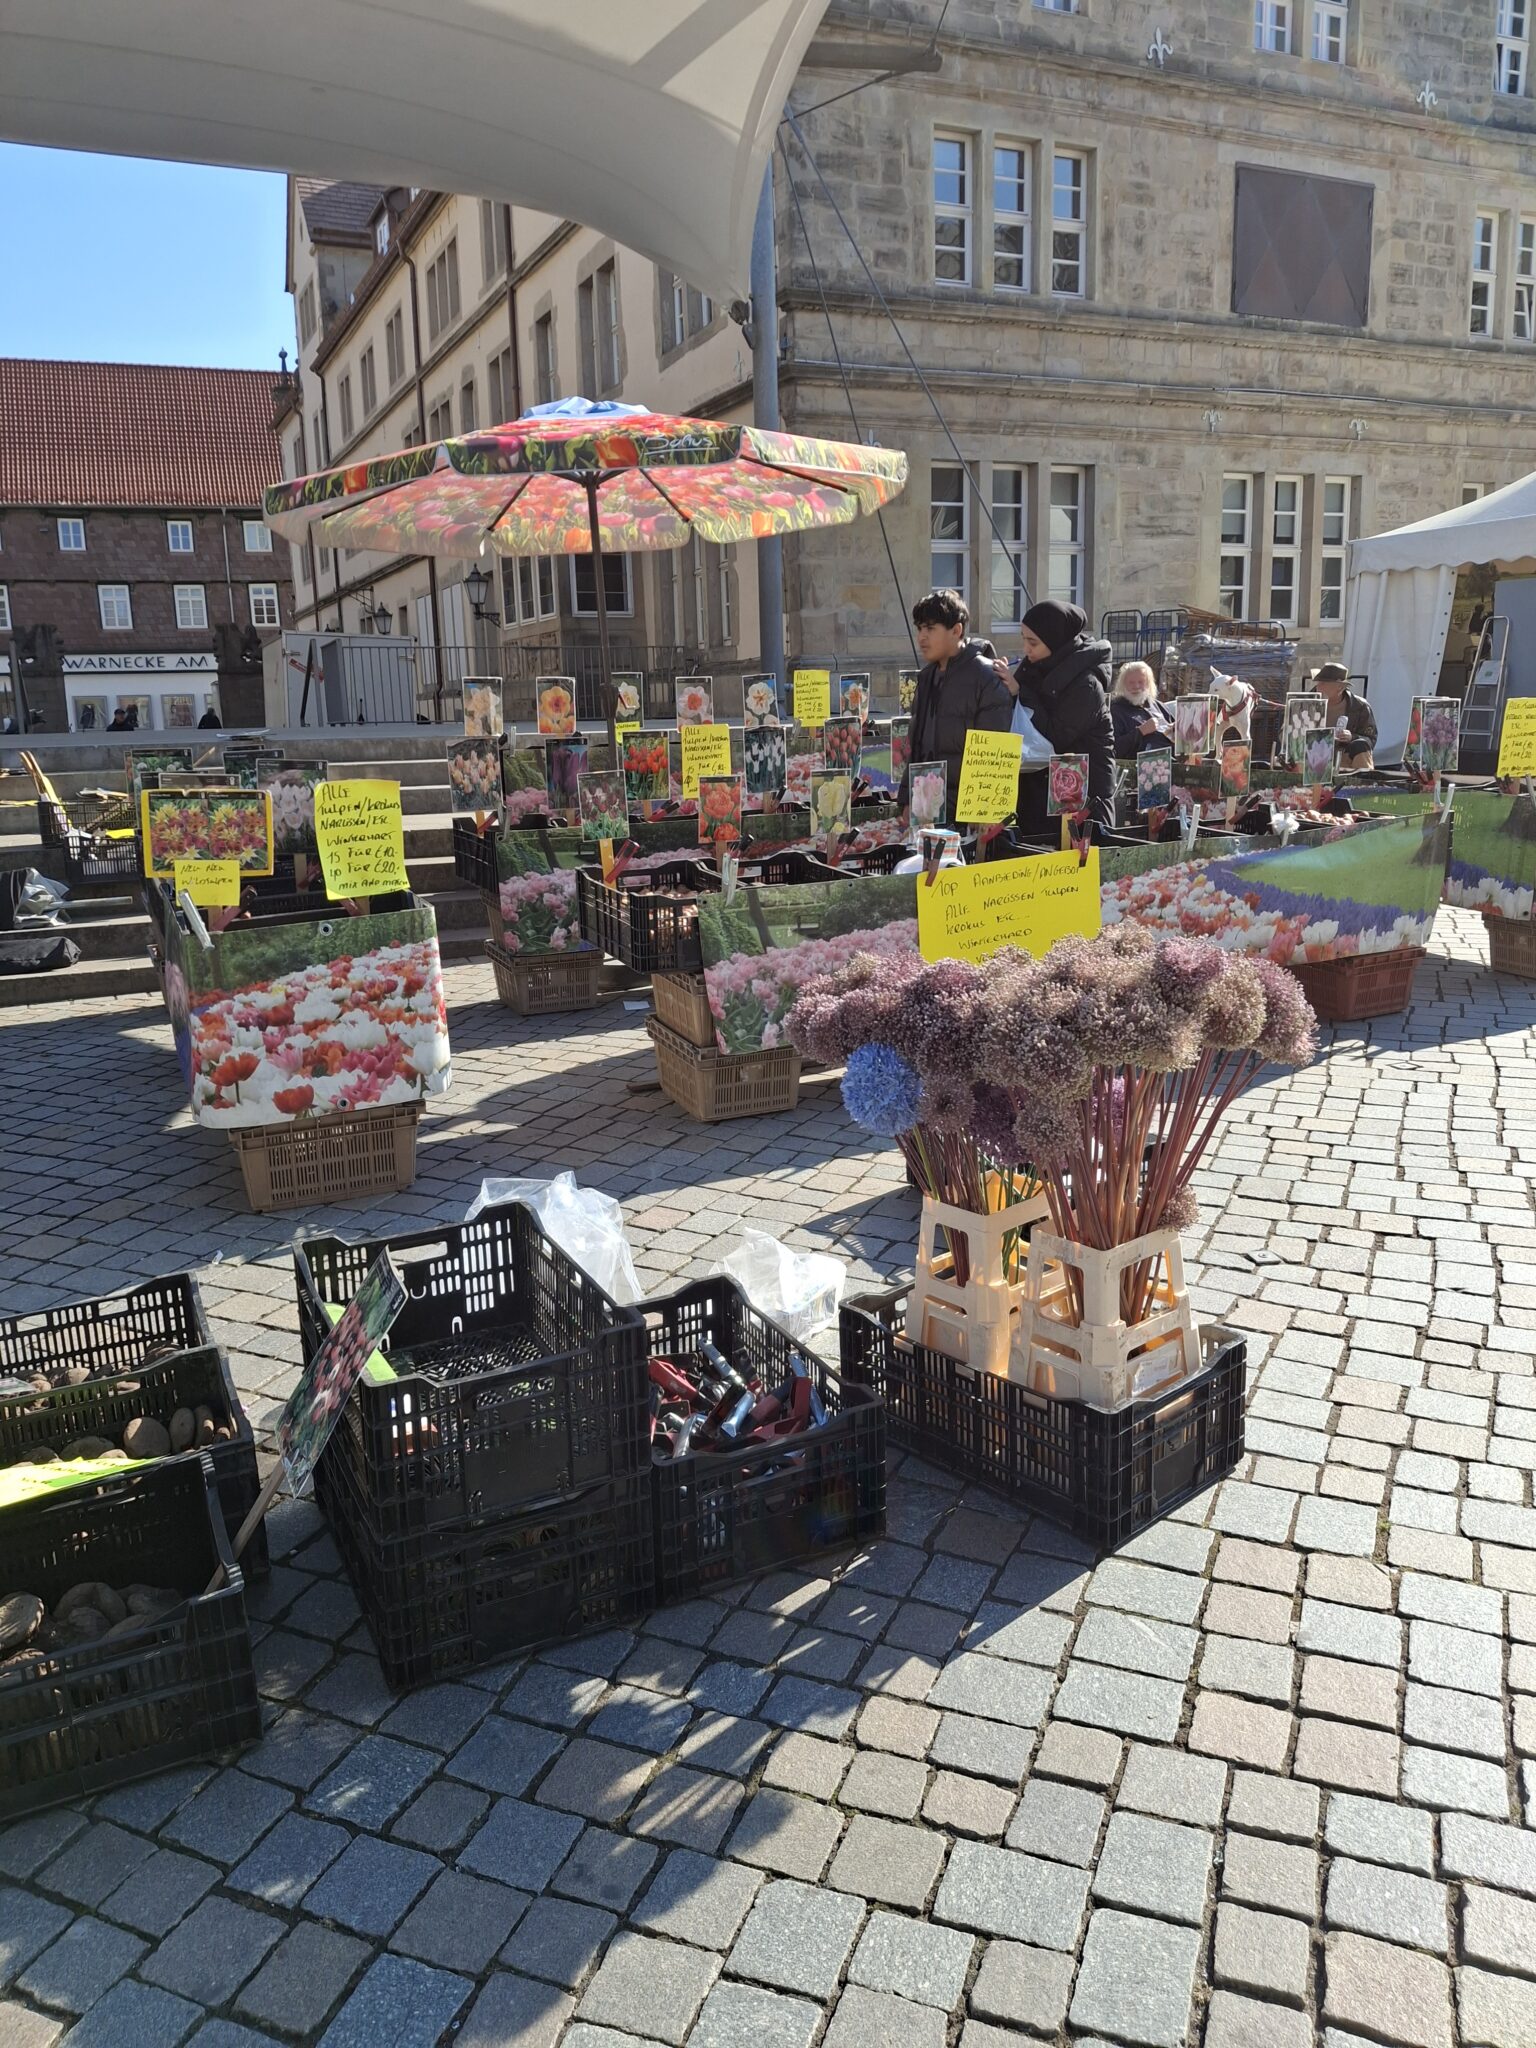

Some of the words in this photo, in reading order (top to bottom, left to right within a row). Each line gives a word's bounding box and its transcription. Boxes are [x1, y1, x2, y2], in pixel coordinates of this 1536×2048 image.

[63, 656, 166, 669] WARNECKE
[175, 656, 208, 668] AM
[971, 733, 990, 745] ALLE
[322, 784, 351, 803] ALLE
[326, 831, 396, 847] WINTERHART
[326, 851, 340, 864] 15
[348, 847, 372, 858] FÜR
[347, 863, 370, 873] FÜR
[339, 881, 357, 890] MIX
[361, 879, 380, 887] AND
[931, 874, 958, 898] TOP
[945, 903, 970, 921] ALLE
[983, 892, 1035, 910] NARCISSEN
[1041, 886, 1079, 897] TULPEN
[946, 920, 985, 935] KROKUS
[958, 928, 1032, 950] WINTERHARD
